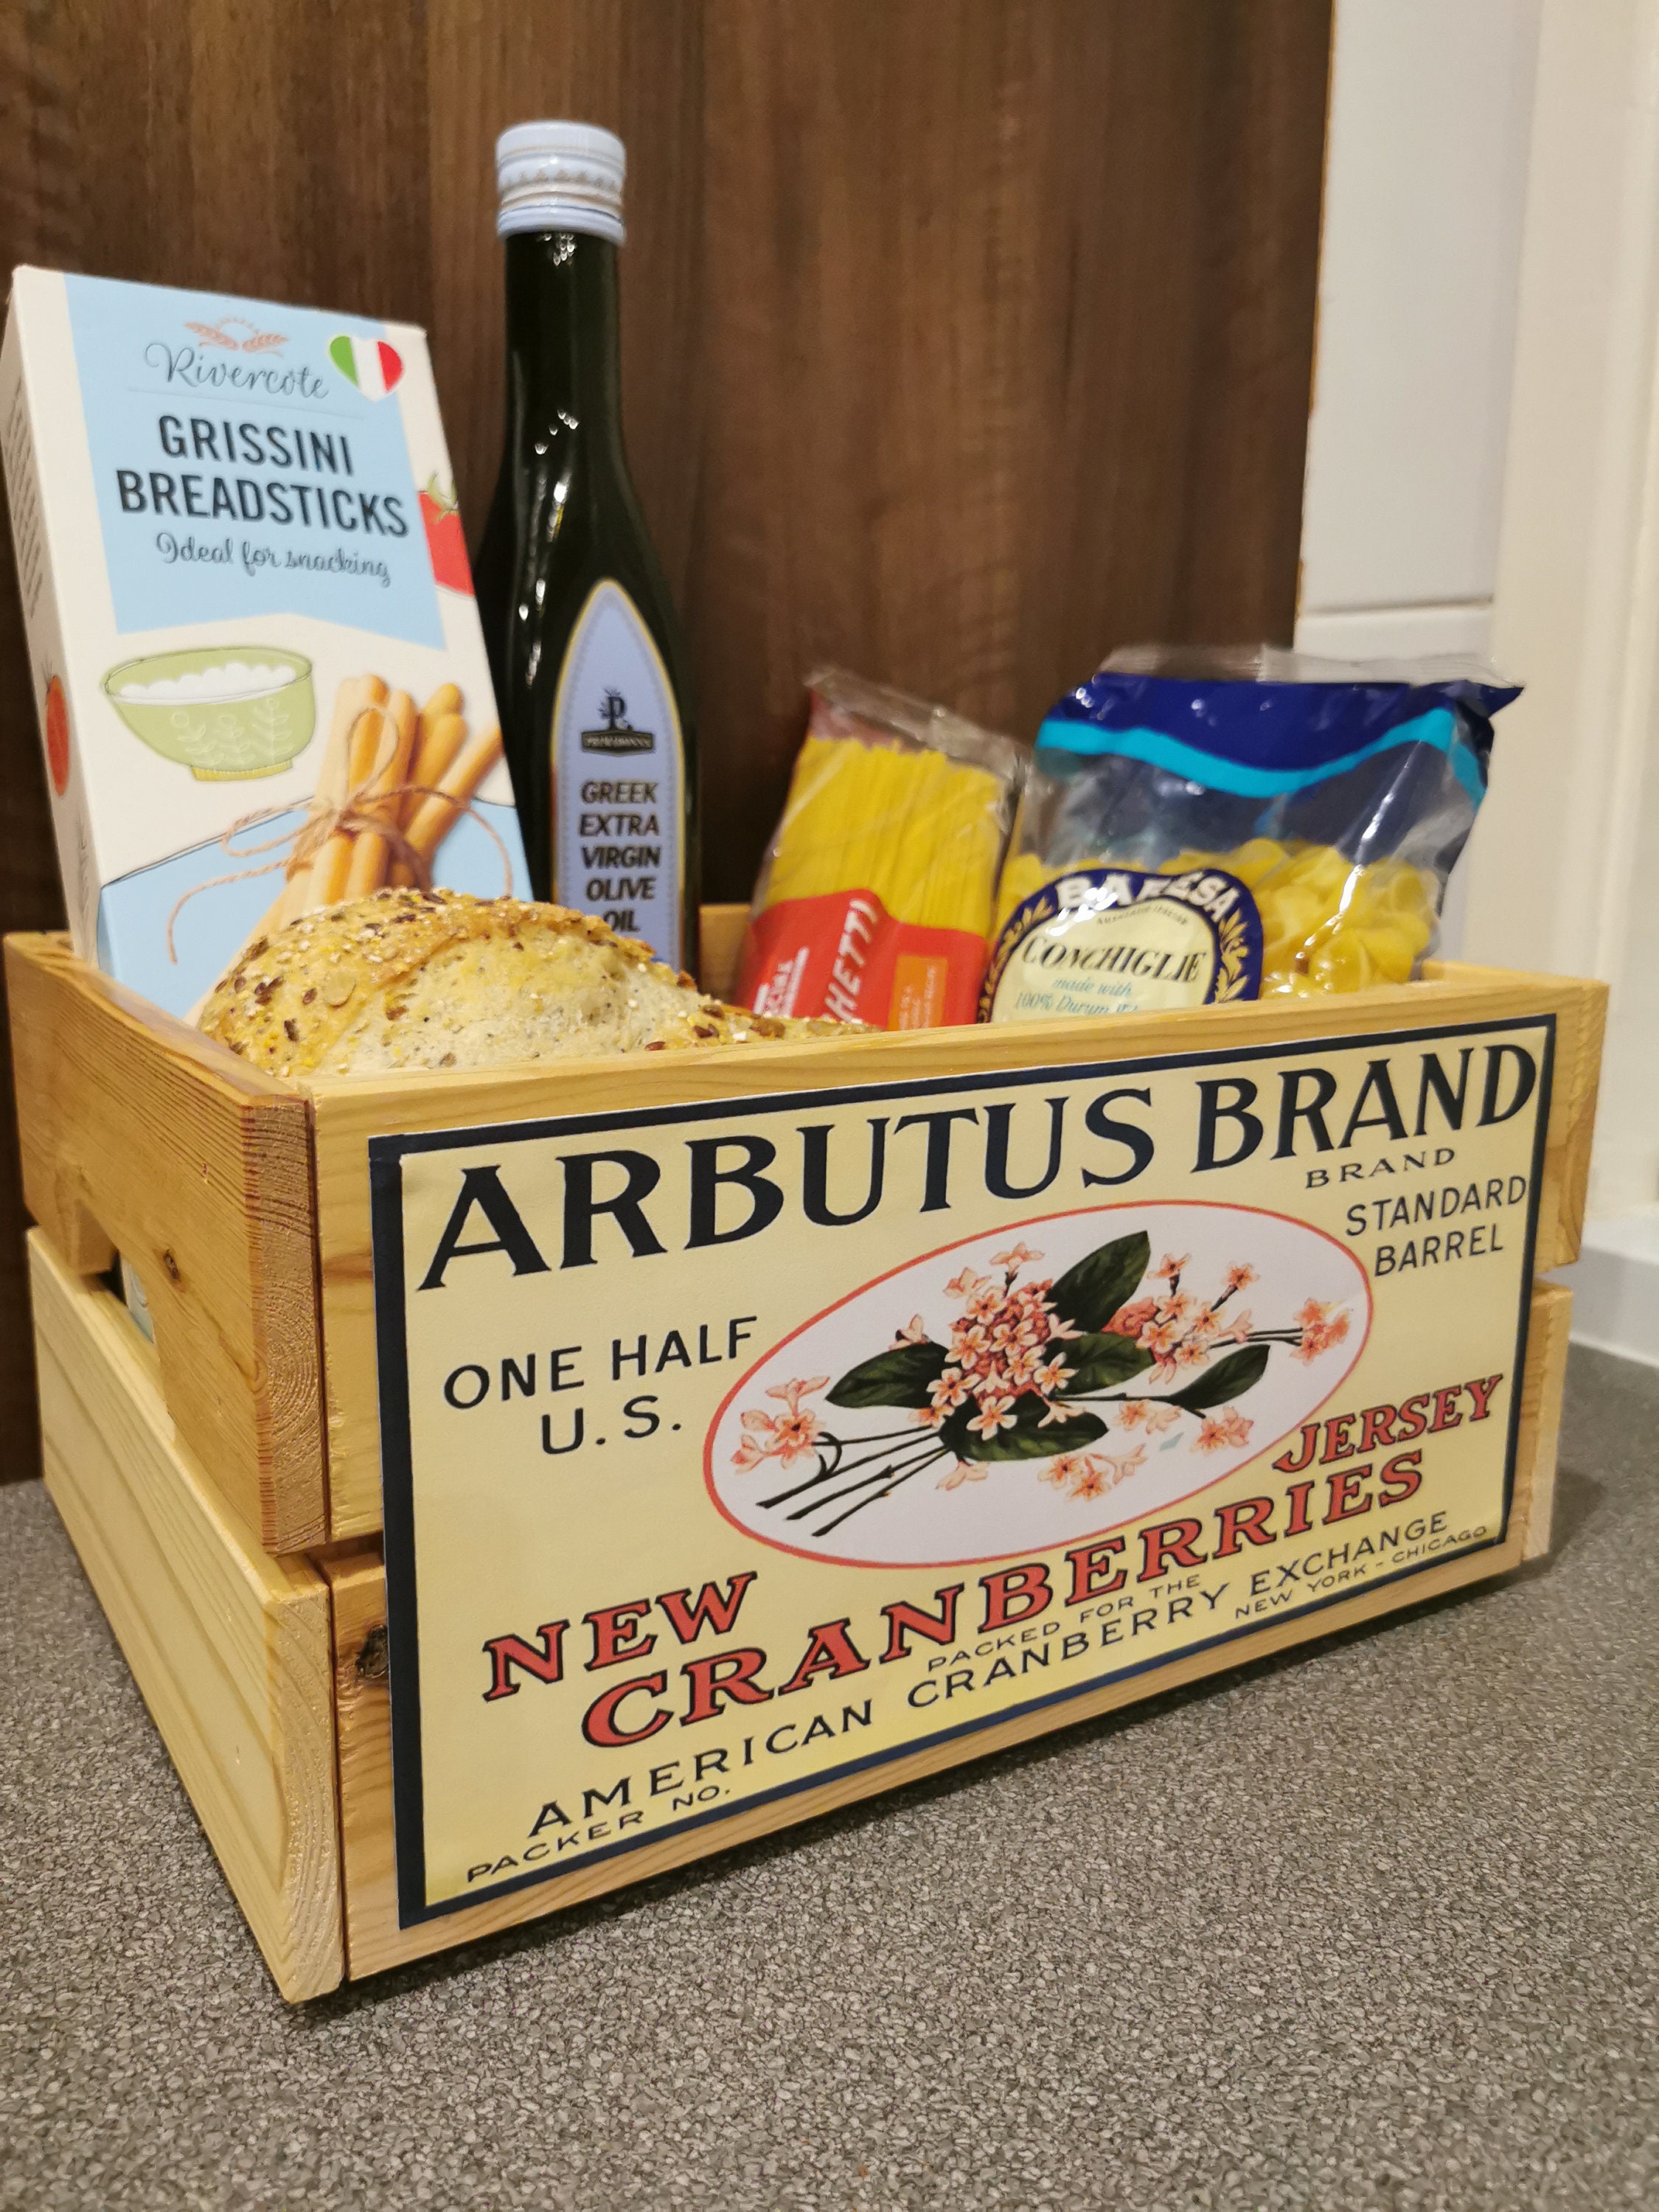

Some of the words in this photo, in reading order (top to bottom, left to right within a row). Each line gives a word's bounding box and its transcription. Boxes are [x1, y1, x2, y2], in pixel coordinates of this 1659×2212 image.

[145, 343, 330, 400] Rivercote
[159, 415, 353, 476] GRISSINI
[116, 470, 409, 538] BREADSTICKS
[156, 532, 232, 563] Ideal
[241, 538, 282, 577] for
[285, 549, 391, 588] snacking
[581, 780, 658, 804] GREEK
[579, 813, 659, 836] EXTRA
[582, 846, 661, 869] VIRGIN
[586, 877, 655, 902] OLIVE
[603, 909, 640, 933] OIL
[1023, 937, 1207, 984] CONCHIGLIE
[1052, 977, 1094, 992] made
[1098, 982, 1132, 997] with
[1016, 992, 1053, 1010] 100%
[415, 1088, 1155, 1292] ARBUTUS
[1190, 1044, 1537, 1173] BRAND
[1305, 1147, 1455, 1189] BRAND
[1346, 1176, 1526, 1237] STANDARD
[1374, 1223, 1503, 1276] BARREL
[444, 1346, 584, 1409] ONE
[611, 1317, 757, 1380] HALF
[541, 1396, 682, 1455] U.S.
[1272, 1374, 1503, 1473] JERSEY
[582, 1450, 1424, 1747] CRANBERRIES
[1235, 1590, 1292, 1618] NEW
[1307, 1562, 1367, 1592] YORK
[1391, 1526, 1486, 1564] CHICAGO
[481, 1571, 758, 1702] NEW
[928, 1622, 1060, 1672] PACKED
[1079, 1596, 1133, 1623] FOR
[1150, 1574, 1201, 1599] THE
[528, 1699, 873, 1837] AMERICAN
[907, 1583, 1230, 1708] CRANBERRY
[1251, 1511, 1447, 1596] EXCHANGE
[467, 1810, 644, 1882] PACKER
[672, 1786, 731, 1811] NO.
